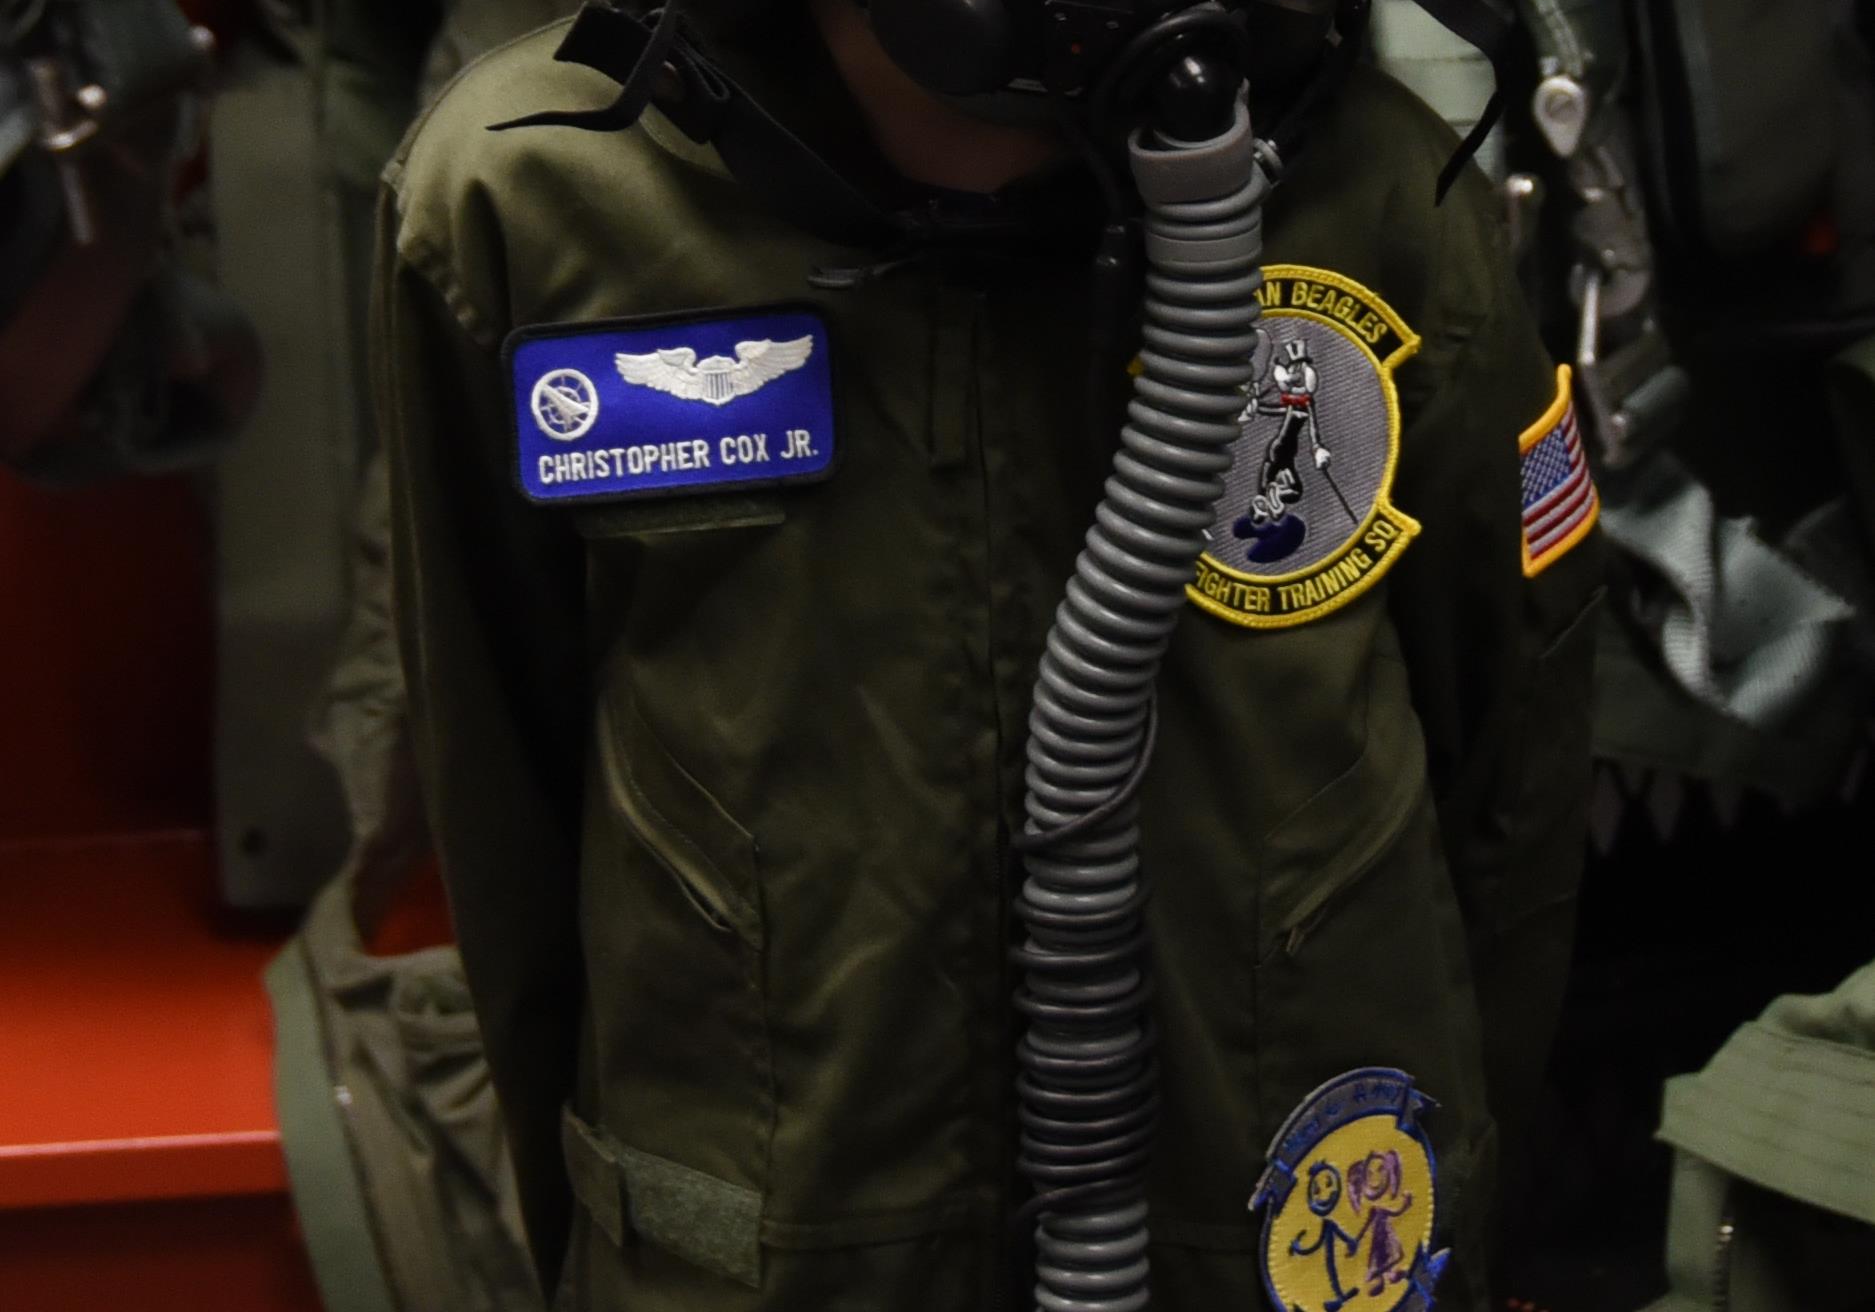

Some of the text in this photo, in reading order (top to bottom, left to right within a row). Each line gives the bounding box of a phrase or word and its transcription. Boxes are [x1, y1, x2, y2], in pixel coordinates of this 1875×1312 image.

[1291, 281, 1388, 344] BEAGLES
[538, 429, 819, 483] CHRISTOPHER COX JR.
[1277, 548, 1373, 610] TRAINING
[1364, 519, 1400, 552] SQ
